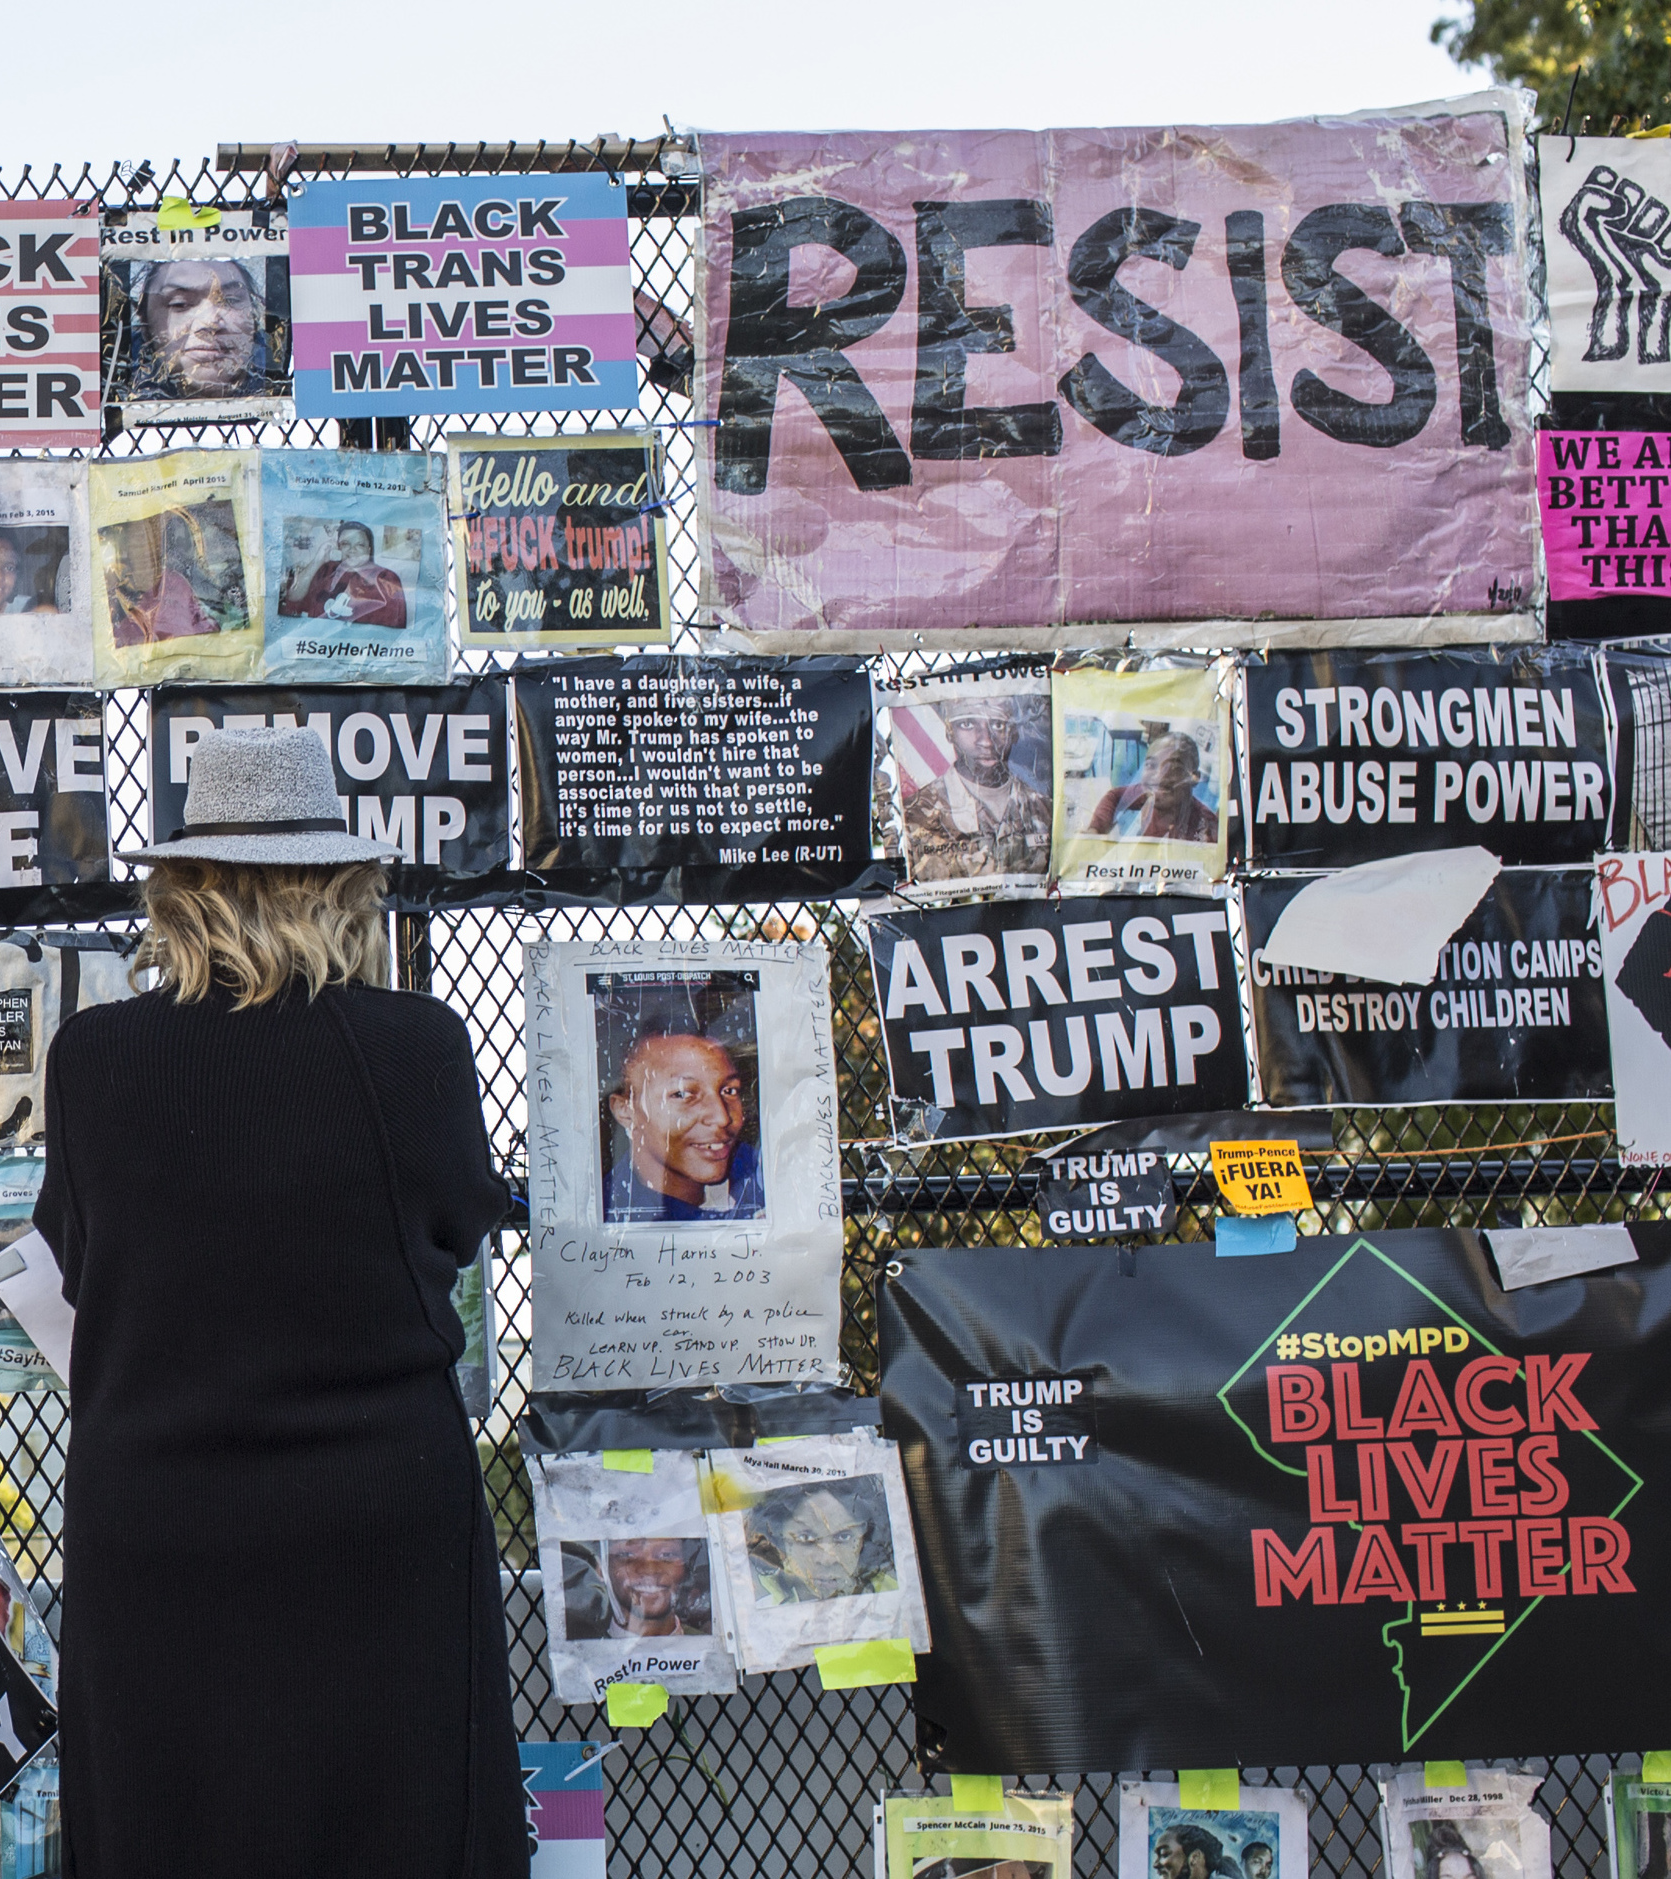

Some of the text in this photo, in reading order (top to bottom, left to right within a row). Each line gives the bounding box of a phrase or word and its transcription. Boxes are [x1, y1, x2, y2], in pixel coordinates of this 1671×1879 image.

[348, 199, 566, 243] BLACK
[348, 250, 566, 291] TRANS
[369, 300, 552, 341] LIVES
[715, 197, 1514, 496] RESIST
[333, 347, 597, 392] MATTER
[1549, 437, 1622, 470] WE
[462, 456, 648, 510] Hello and
[469, 514, 651, 584] #FUCK trump!
[1582, 554, 1671, 588] THI
[476, 575, 650, 632] to you as well.
[295, 640, 415, 660] #SayHerName
[574, 676, 615, 691] have
[621, 679, 632, 690] a
[637, 674, 721, 693] daughter,
[726, 678, 737, 690] a
[742, 675, 786, 692] wife,
[791, 679, 802, 690] a
[1274, 687, 1577, 748] STRONGMEN
[1256, 761, 1605, 825] ABUSE POWER
[719, 845, 843, 864] Mike Lee (R-UT)
[634, 972, 655, 982] LOUIS
[656, 972, 712, 982] POST-DISPATCH
[885, 911, 1227, 1020] ARREST
[1511, 939, 1603, 980] CAMPS
[1295, 987, 1571, 1033] DESTROY CHILDREN
[909, 1005, 1222, 1110] TRUMP
[1046, 1152, 1158, 1180] TRUMP
[1216, 1147, 1296, 1160] Trump-Pence
[1089, 1181, 1121, 1205] IS
[1245, 1182, 1282, 1201] YA!
[1048, 1203, 1167, 1234] GUILTY
[559, 1233, 763, 1272] Clayton Harris Jr.
[626, 1273, 651, 1288] Feb
[714, 1269, 772, 1285] 2003
[1276, 1327, 1470, 1363] #StopMPD
[553, 1353, 825, 1380] BLACK LIVES MATTER
[966, 1380, 1084, 1408] TRUMP
[1265, 1353, 1601, 1444] BLACK
[1011, 1409, 1043, 1434] IS
[967, 1435, 1090, 1463] GUILTY
[1305, 1435, 1570, 1524] LIVES
[1250, 1516, 1637, 1608] MATTER
[917, 1821, 952, 1831] Spencer
[954, 1821, 986, 1829] McCain
[990, 1823, 1011, 1831] June
